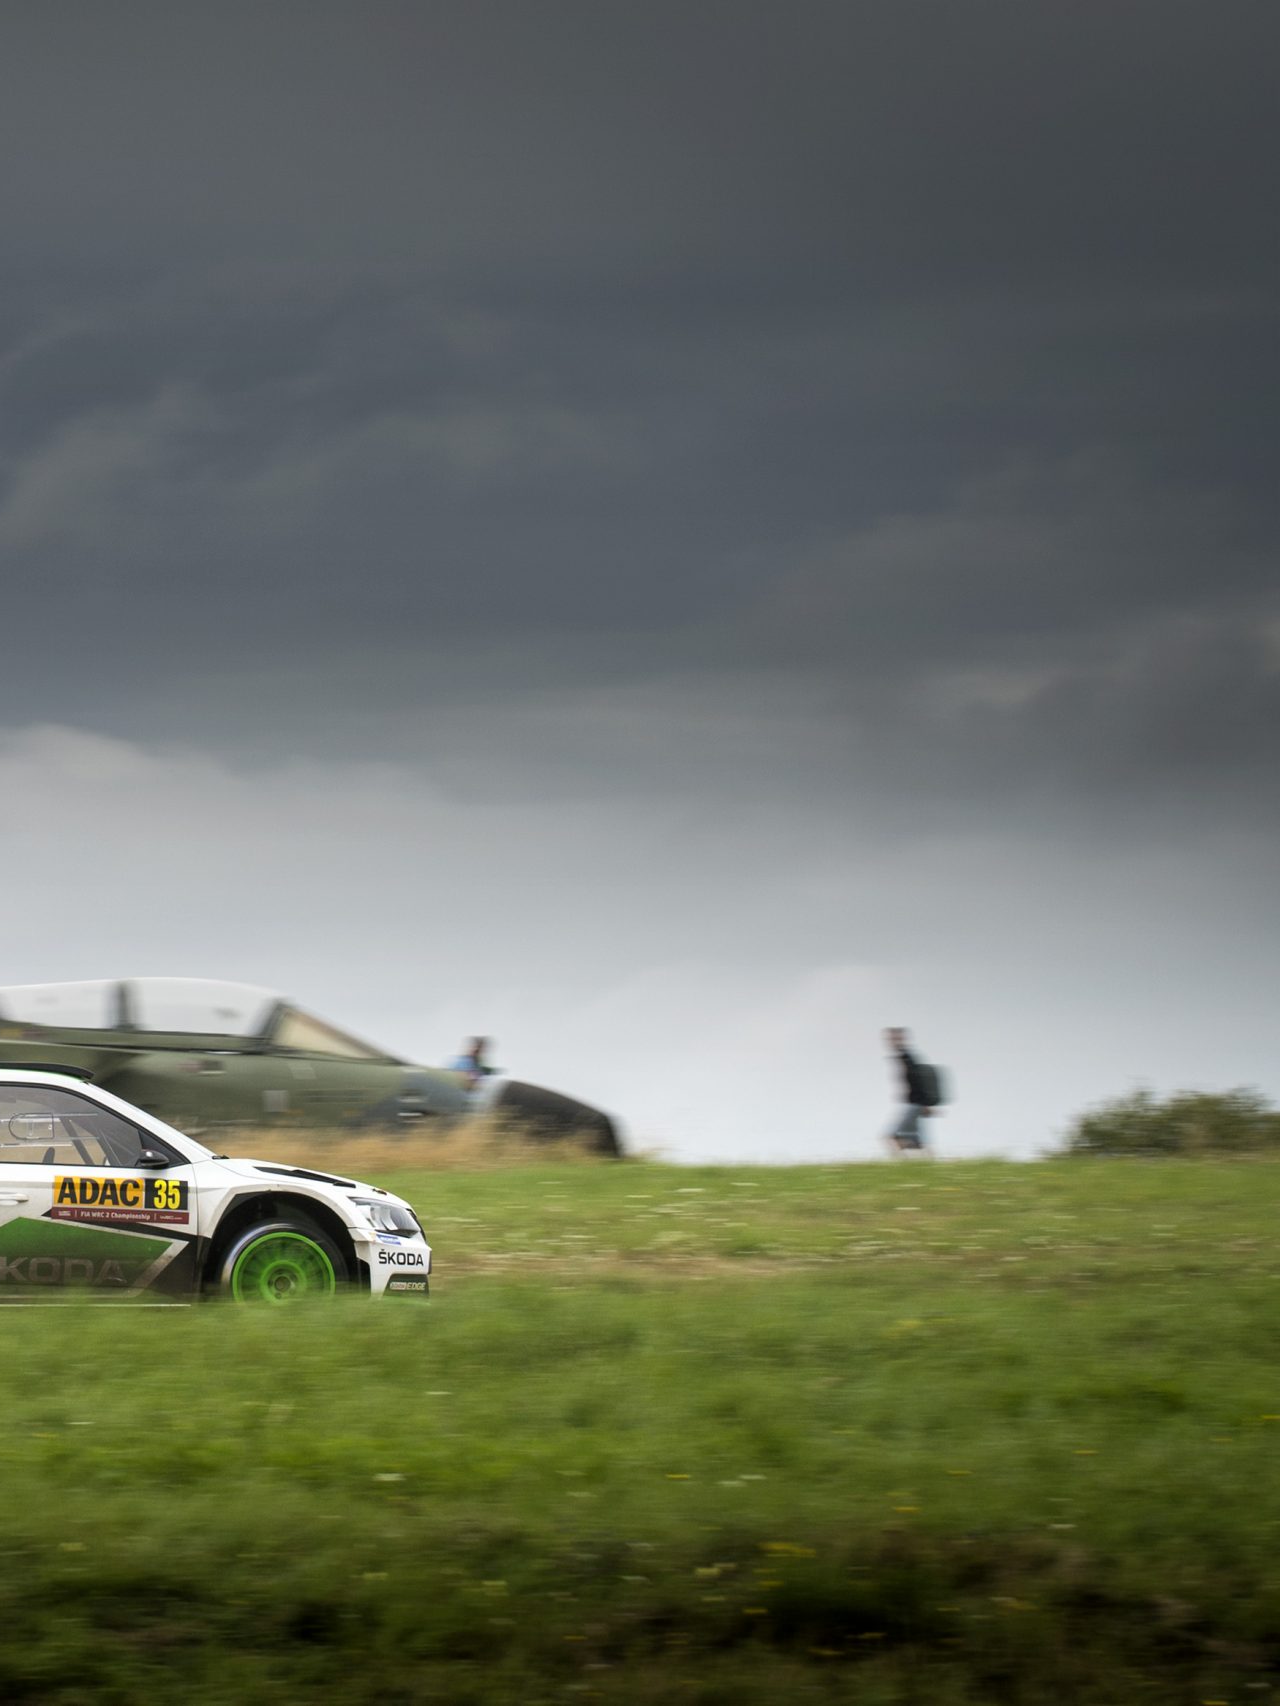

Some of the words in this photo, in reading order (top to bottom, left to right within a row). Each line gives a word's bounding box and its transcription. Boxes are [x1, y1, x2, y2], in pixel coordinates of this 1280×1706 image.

[57, 1177, 140, 1207] ADAC
[153, 1179, 181, 1210] 35
[111, 1212, 151, 1221] Championship
[378, 1248, 424, 1267] ŠKODA
